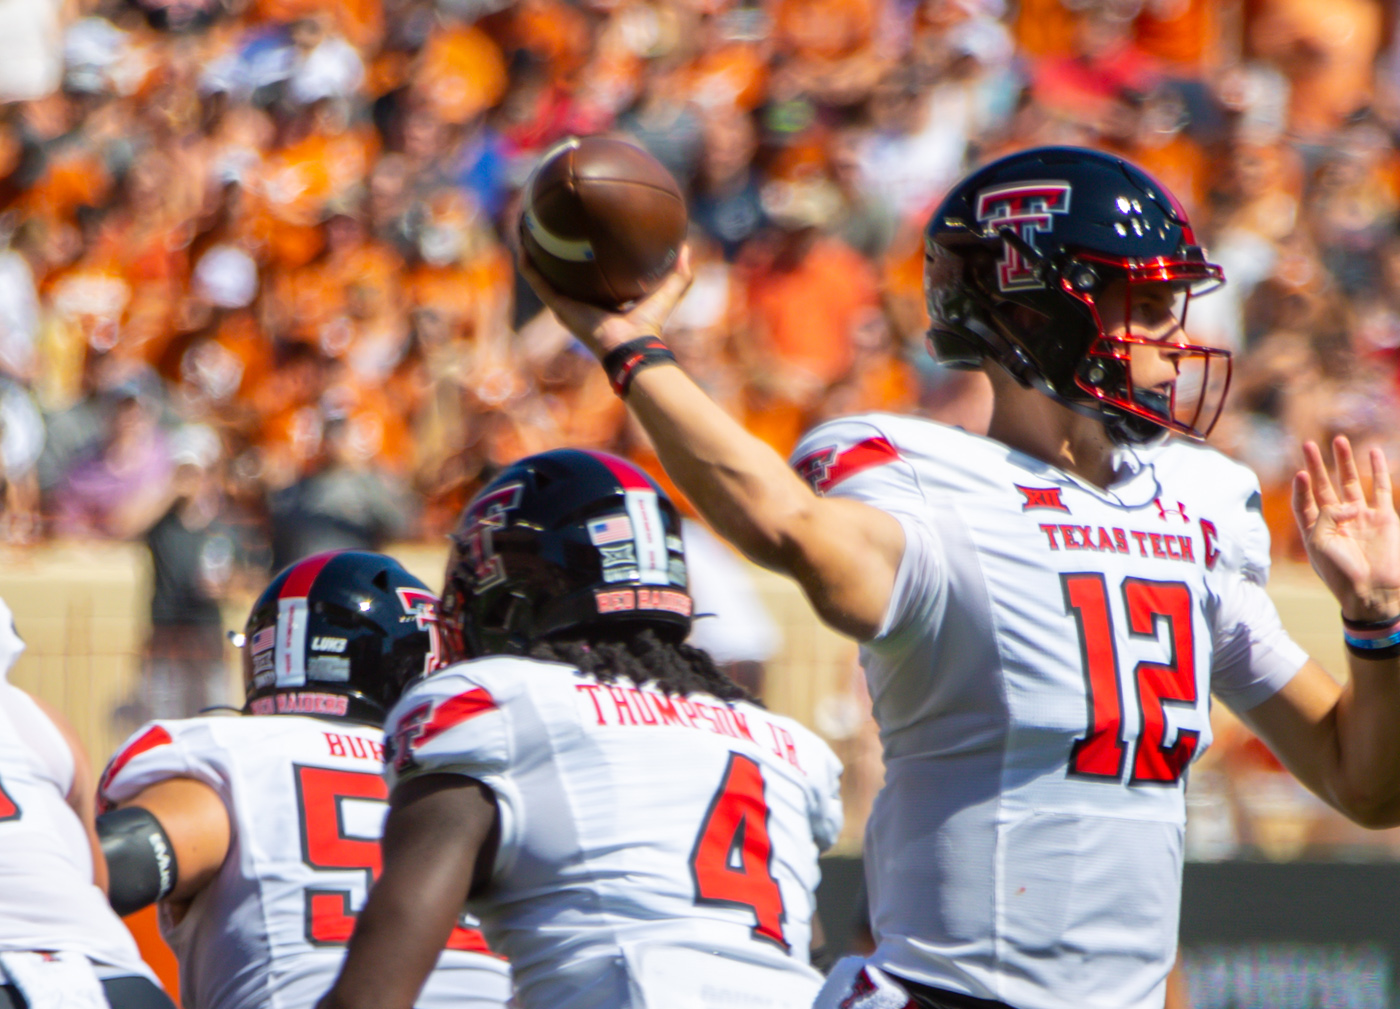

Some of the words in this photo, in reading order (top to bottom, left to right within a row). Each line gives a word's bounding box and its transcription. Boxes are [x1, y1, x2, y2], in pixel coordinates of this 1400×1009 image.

[1038, 523, 1131, 555] TEXAS
[1130, 530, 1196, 564] TECH
[1199, 517, 1221, 572] C
[1059, 571, 1201, 786] 12
[575, 684, 762, 747] THOMPSON
[322, 732, 386, 764] BUR
[688, 750, 792, 957] 4
